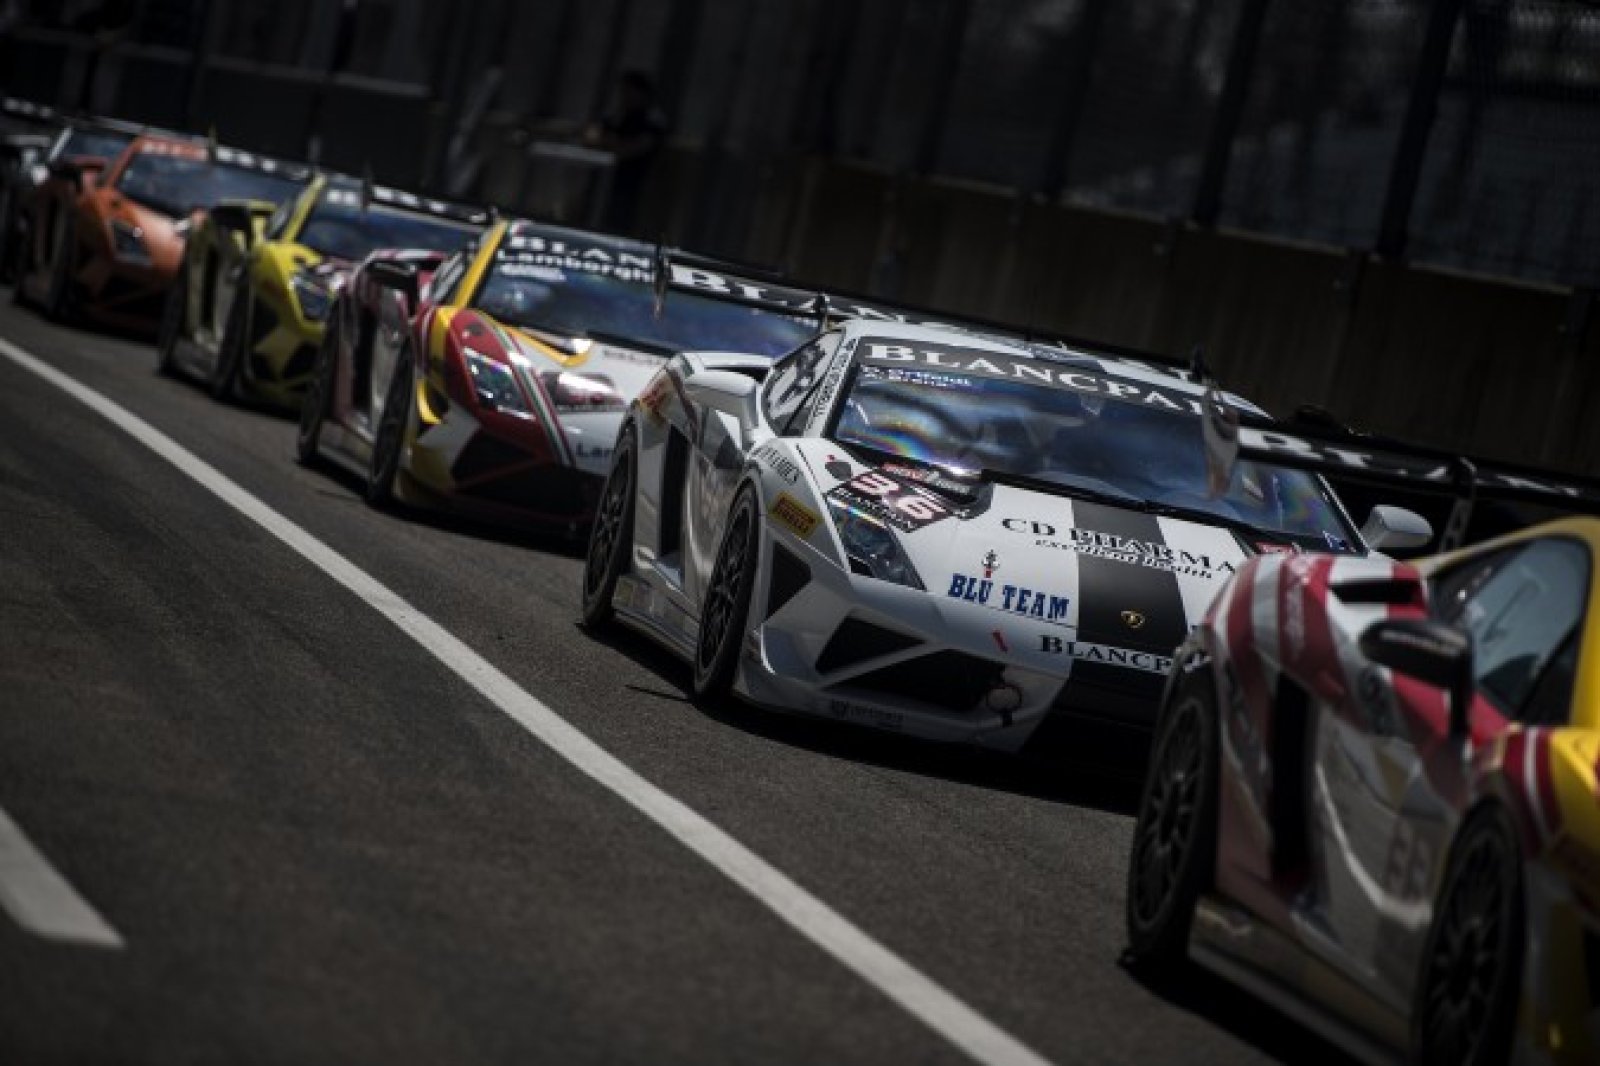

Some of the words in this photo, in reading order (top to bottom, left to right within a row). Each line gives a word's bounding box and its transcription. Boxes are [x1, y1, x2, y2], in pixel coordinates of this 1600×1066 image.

[1002, 517, 1056, 536] CD
[1069, 528, 1236, 574] PHARMA
[948, 572, 994, 604] BLU
[1002, 584, 1070, 620] TEAM
